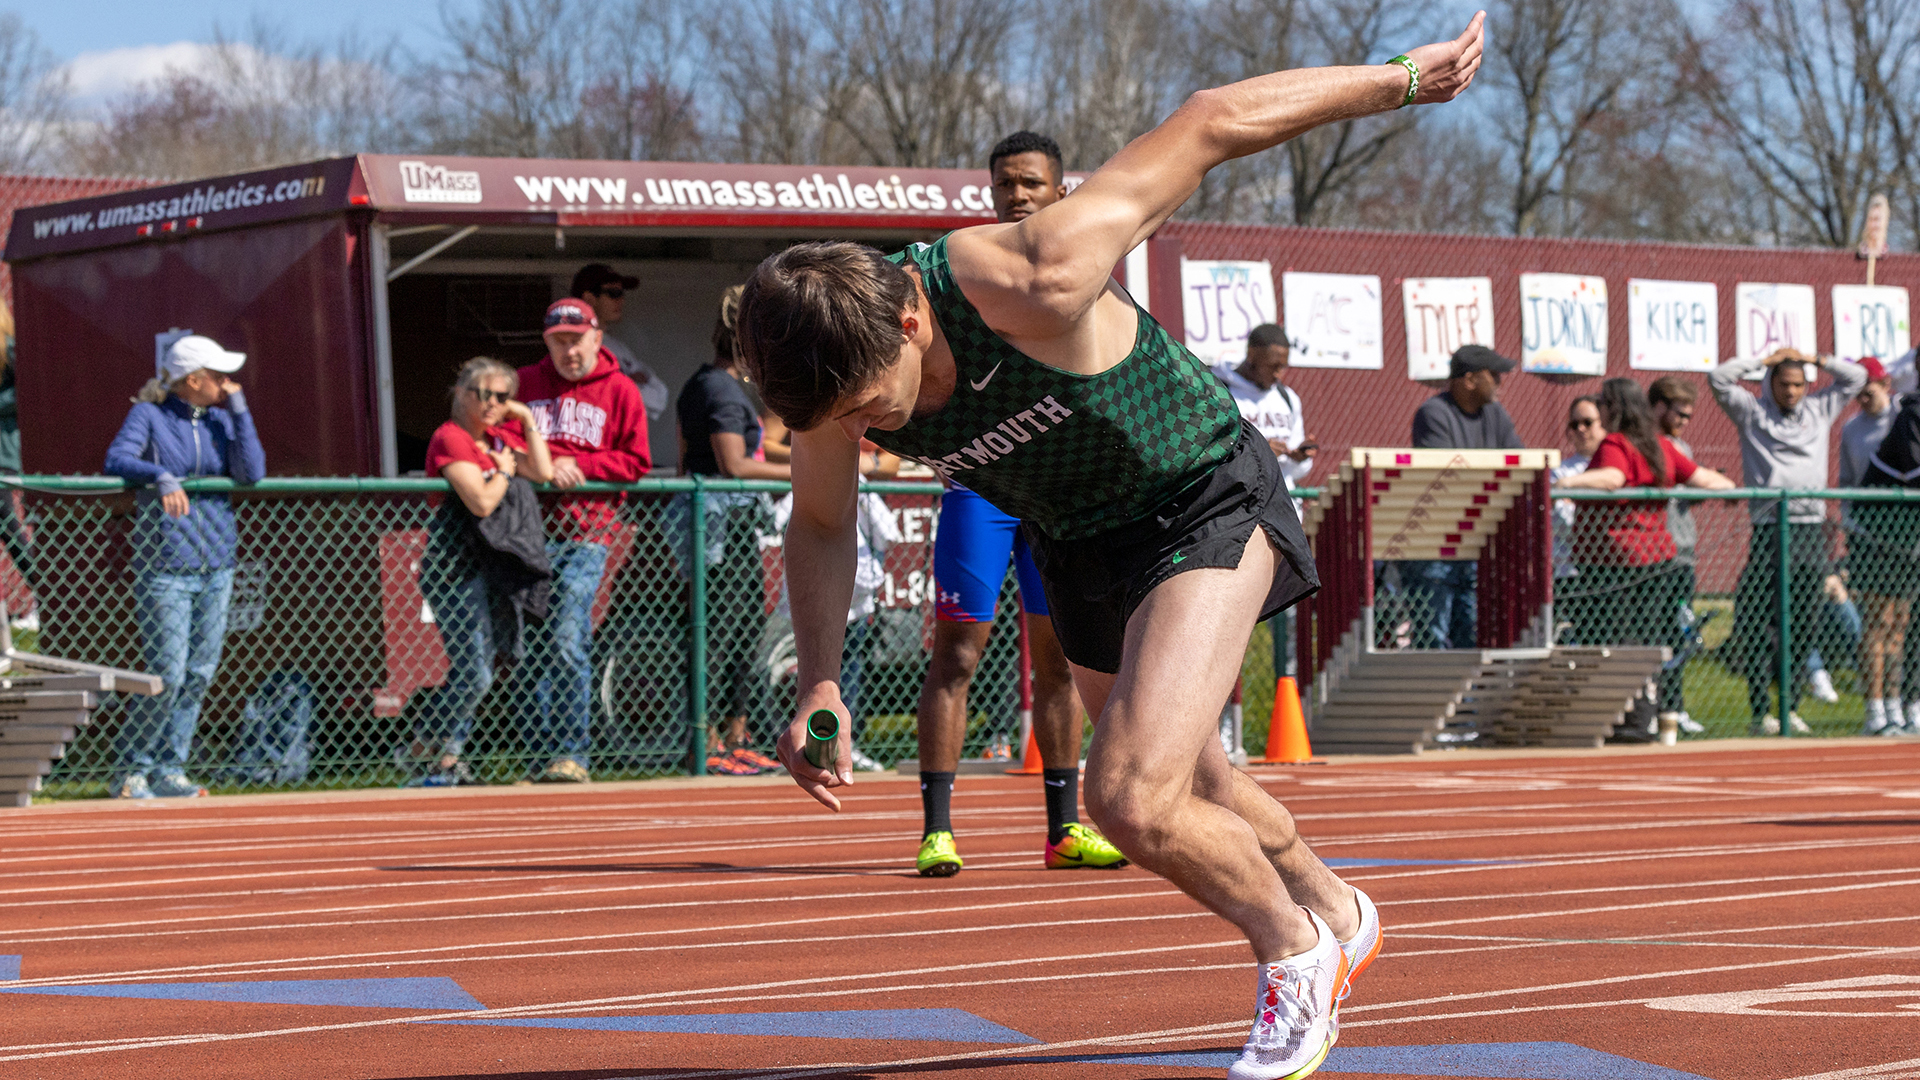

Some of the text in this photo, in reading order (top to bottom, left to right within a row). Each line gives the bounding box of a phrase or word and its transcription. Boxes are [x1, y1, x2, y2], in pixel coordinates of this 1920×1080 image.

[33, 175, 326, 240] www.umassathletics.com
[514, 174, 995, 212] www.umassathletics.co
[1646, 300, 1707, 345] KIRA
[884, 569, 936, 607] 1-8
